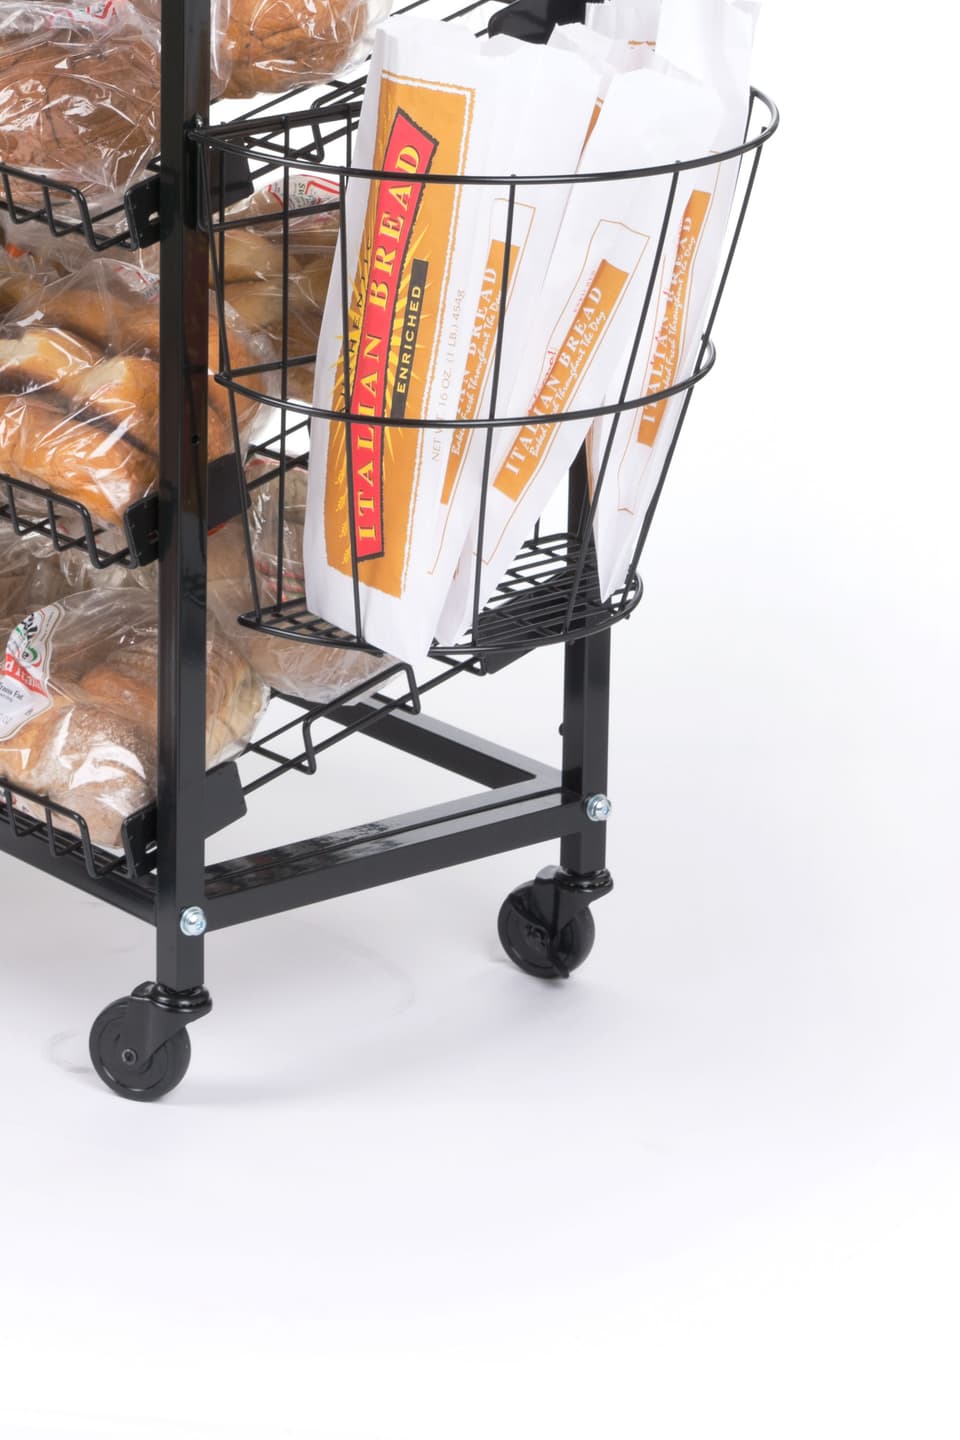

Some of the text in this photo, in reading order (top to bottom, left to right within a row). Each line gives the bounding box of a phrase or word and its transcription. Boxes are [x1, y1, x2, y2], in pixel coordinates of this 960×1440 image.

[357, 144, 420, 541] ITALIAN BREAD
[396, 285, 421, 393] ENRICHED
[558, 287, 603, 368] BREAD
[581, 330, 595, 351] The
[591, 310, 606, 332] Day
